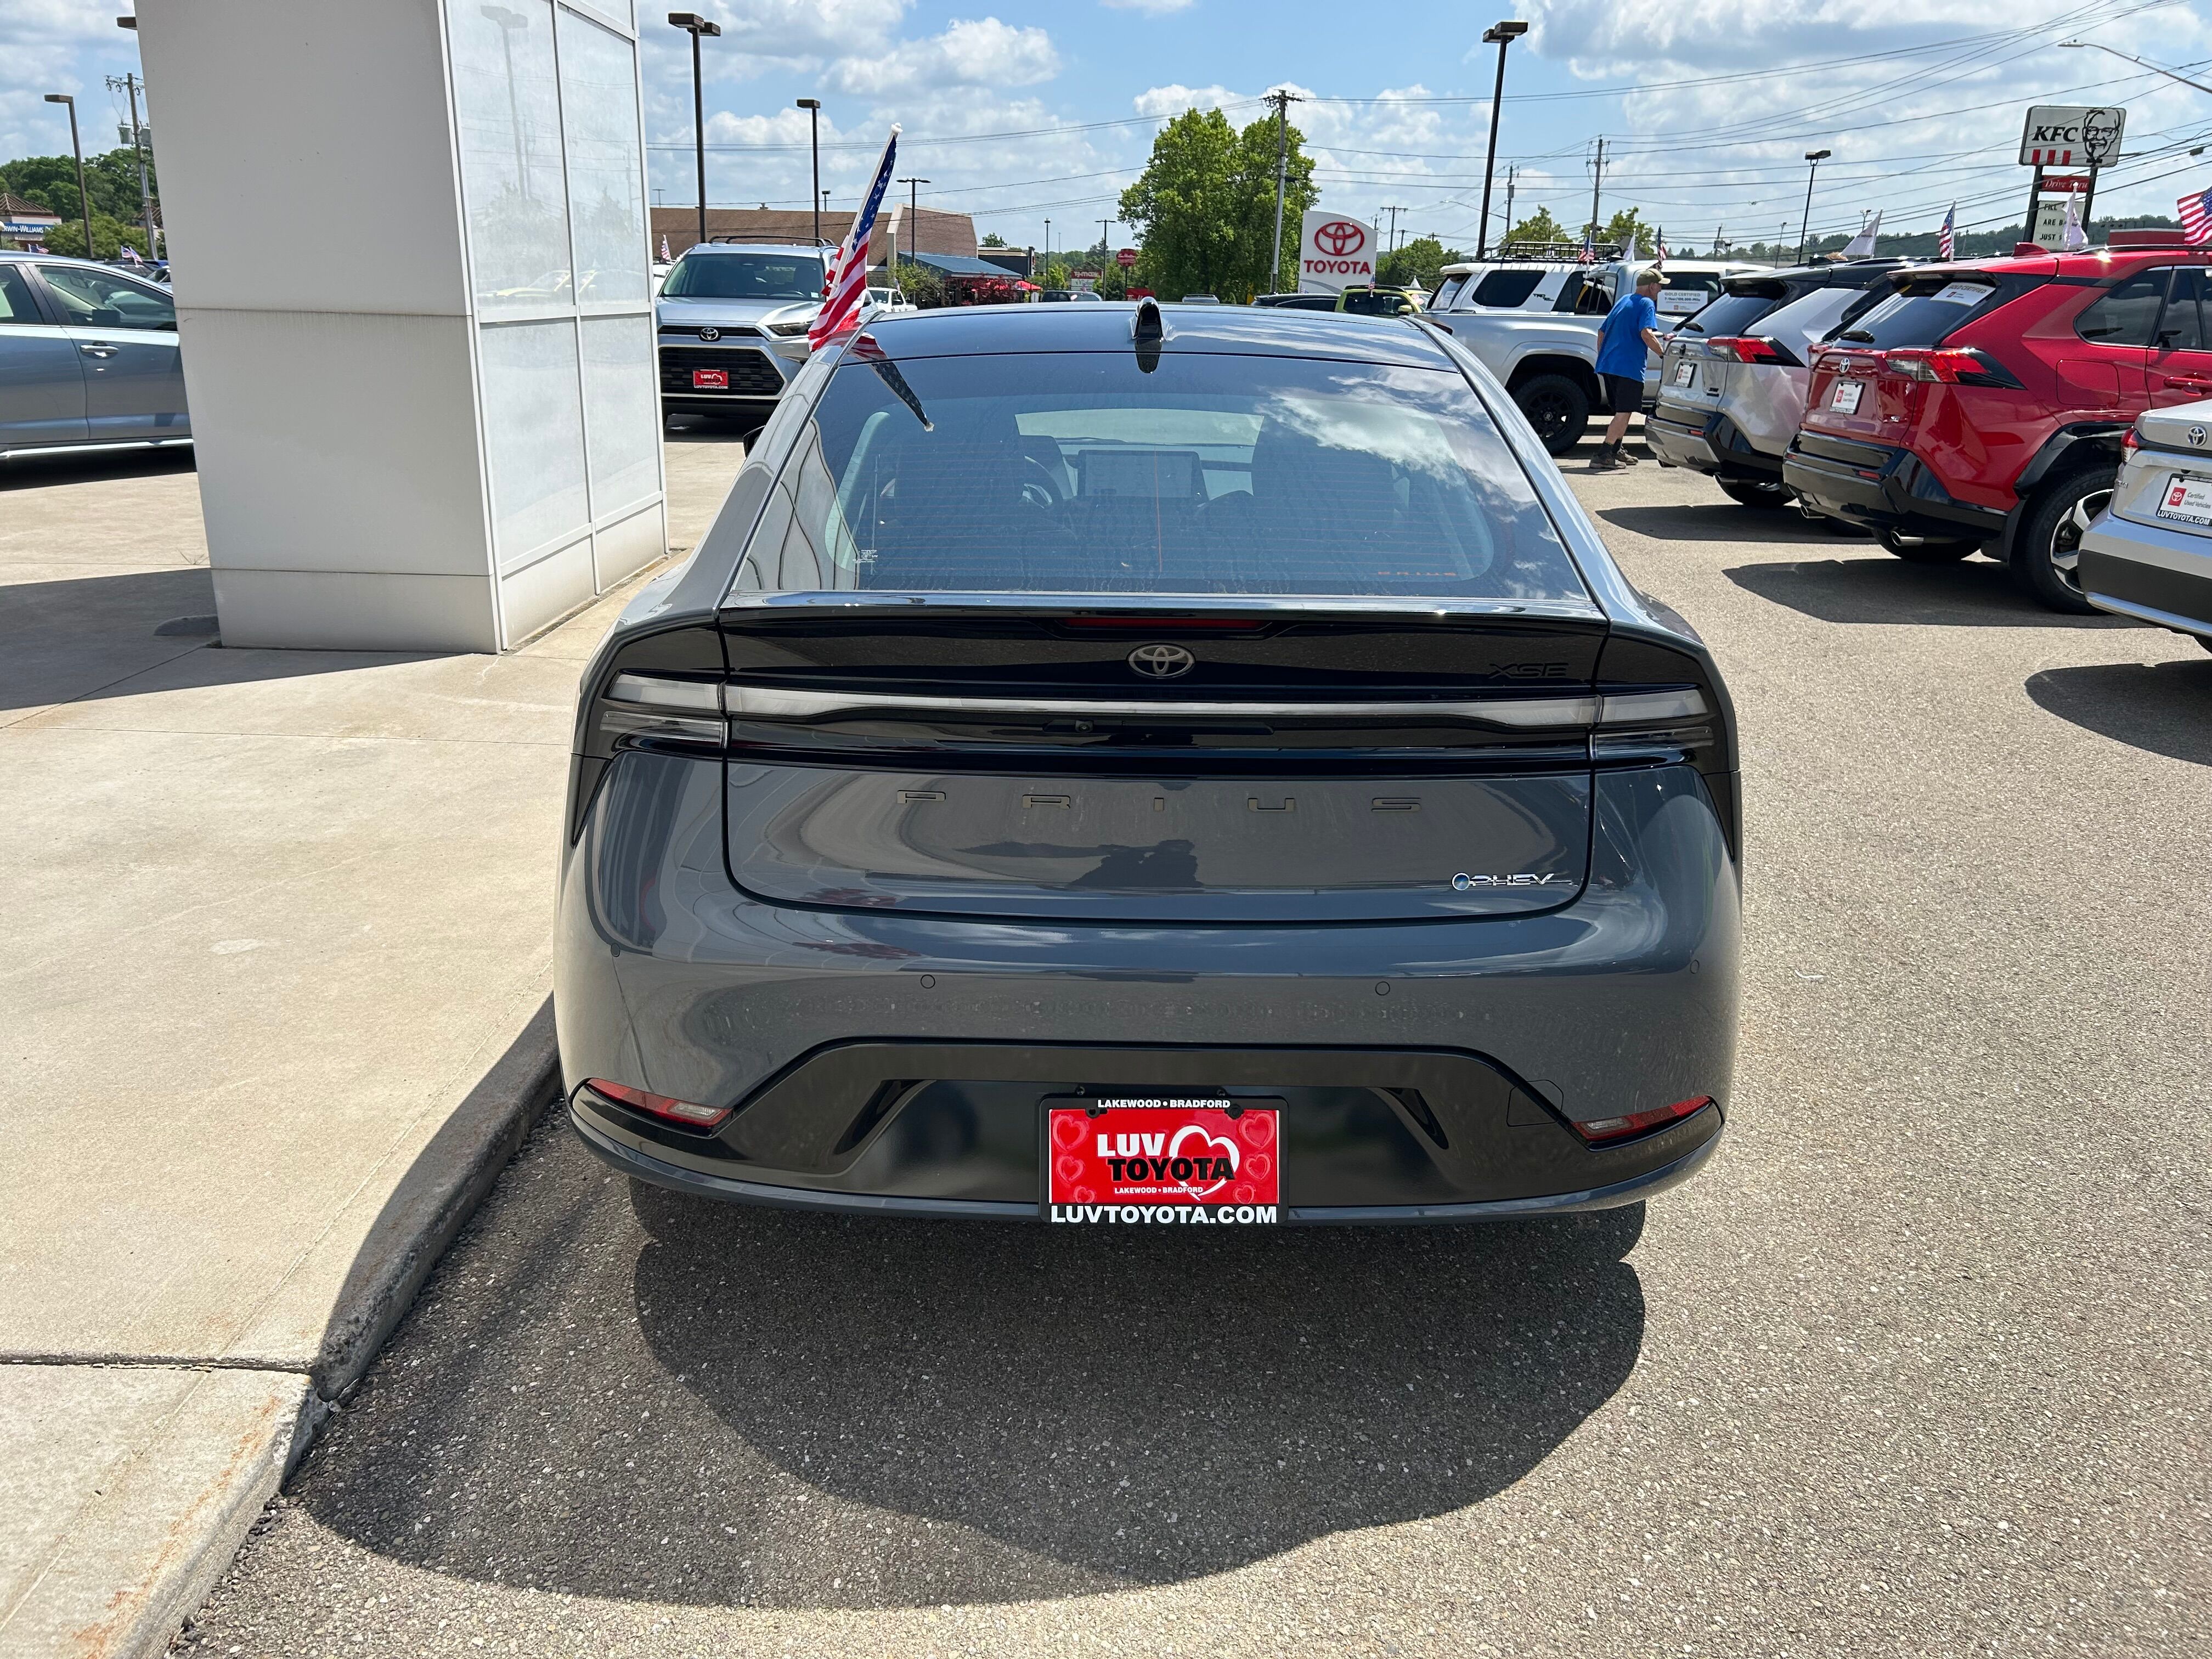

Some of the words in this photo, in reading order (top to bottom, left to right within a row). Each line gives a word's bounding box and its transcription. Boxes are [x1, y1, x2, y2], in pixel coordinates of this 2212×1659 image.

[2032, 126, 2079, 142] KFC
[2045, 180, 2066, 188] Drive
[2069, 180, 2088, 188] Tru
[4, 225, 43, 233] RWIN-WILLIAMS
[1304, 260, 1370, 274] TOYOTA
[2157, 510, 2210, 526] LUVTOYOTA.COM
[1488, 662, 1569, 679] XSE
[897, 789, 1421, 812] PRIUS
[1470, 873, 1554, 887] PHEV
[1098, 1099, 1160, 1108] LAKEWOOD
[1170, 1099, 1231, 1108] BRADFORD
[1098, 1133, 1165, 1157] LUV
[1107, 1158, 1235, 1181] TOYOTA
[1051, 1205, 1277, 1223] LUVTOYOTA.COM
